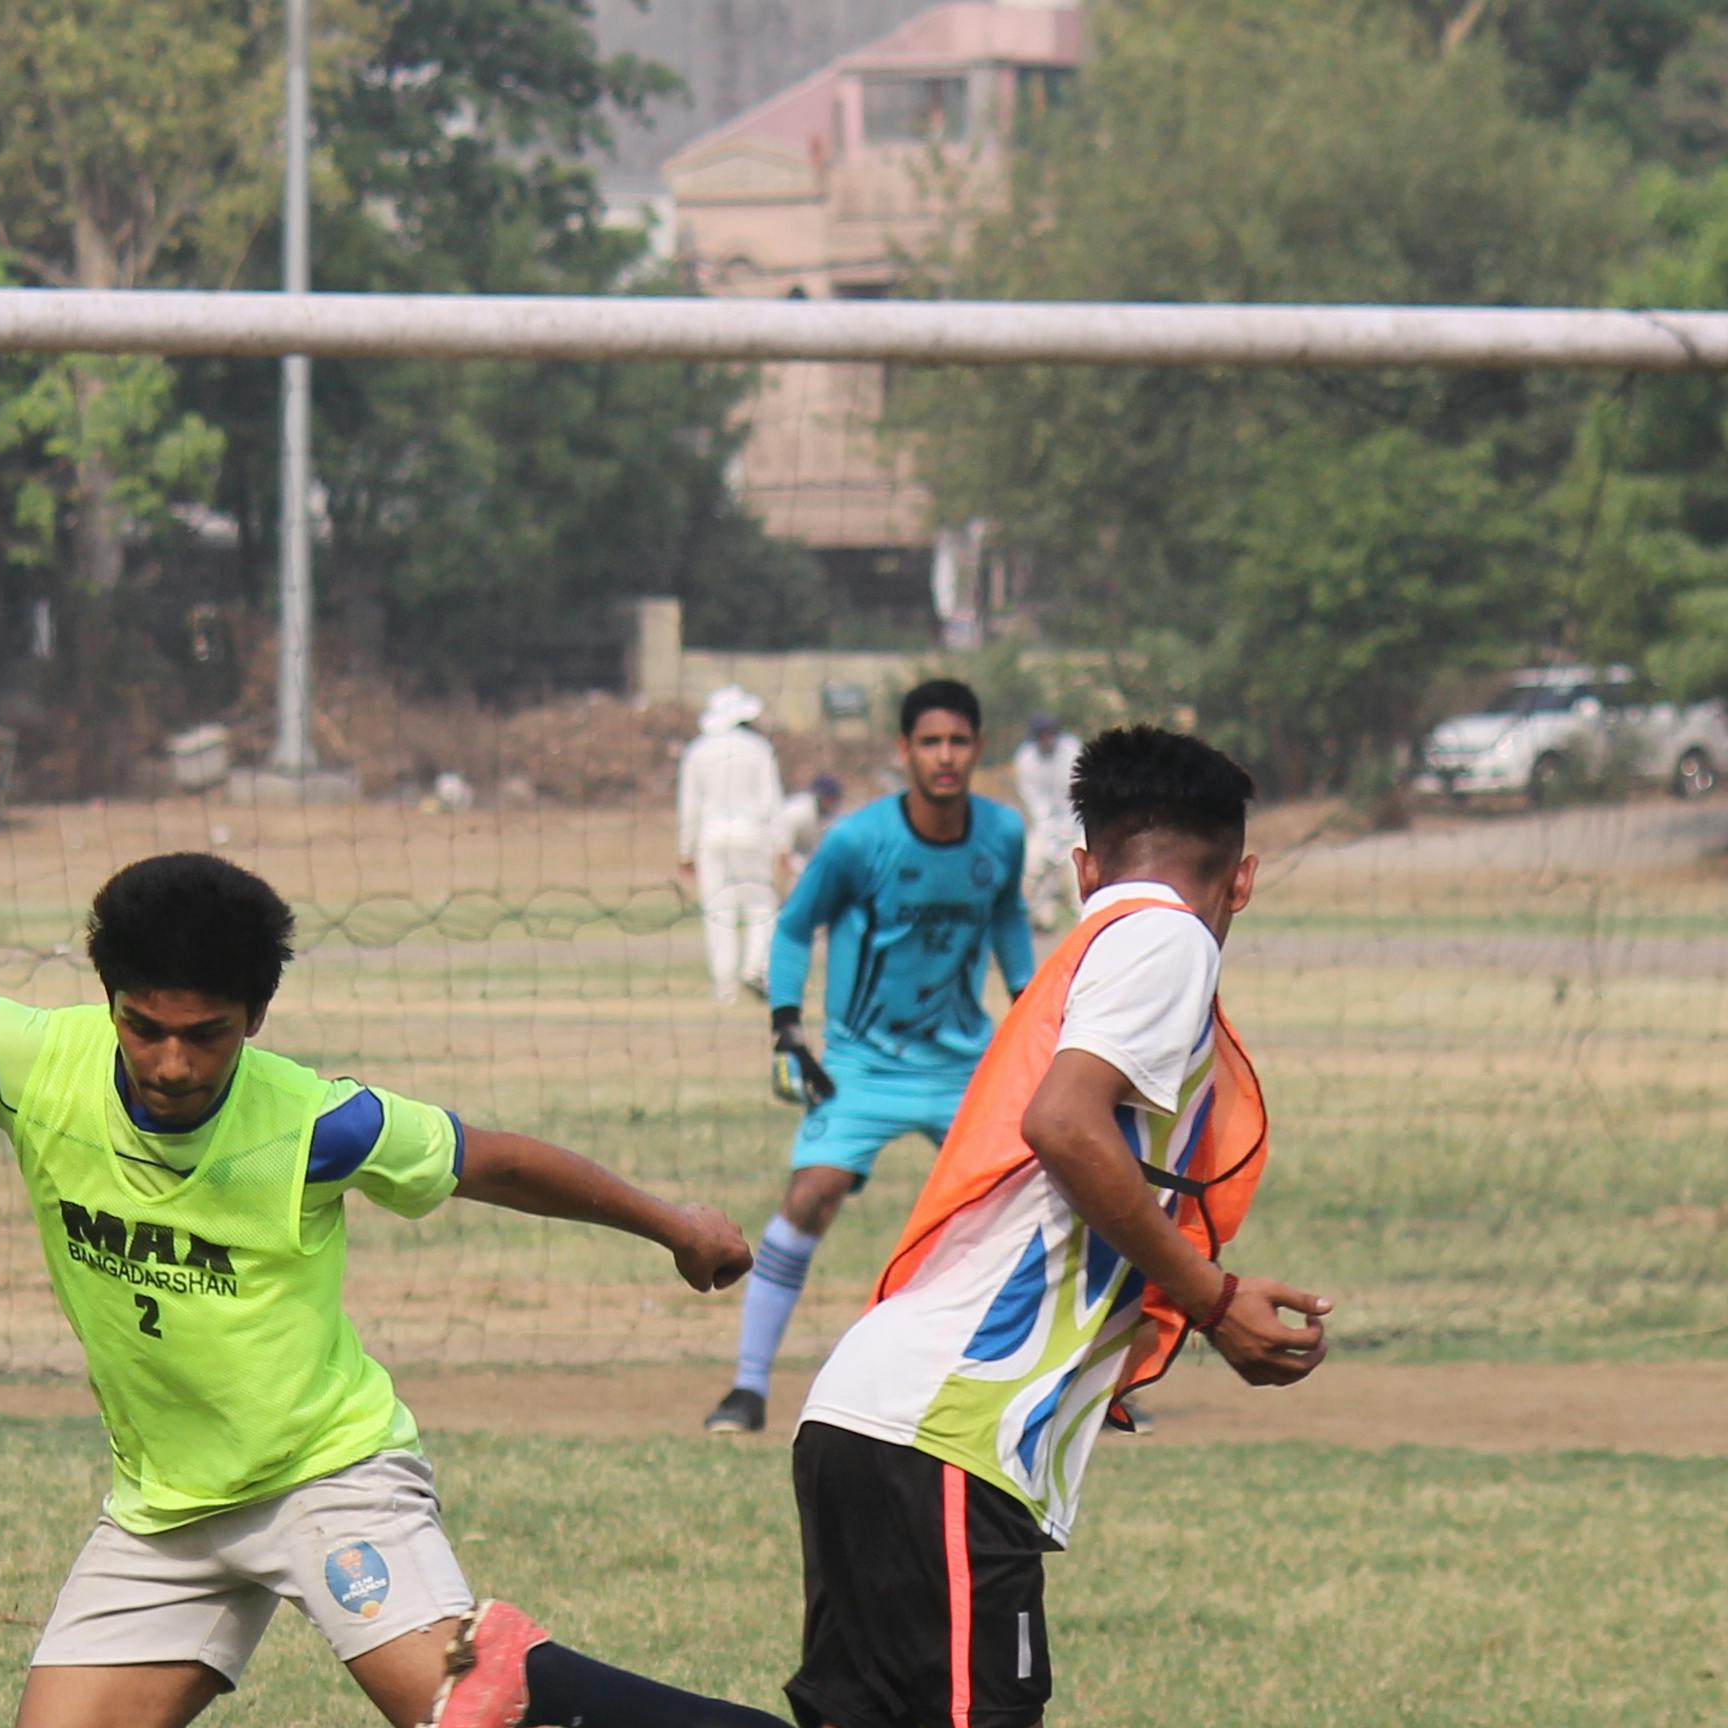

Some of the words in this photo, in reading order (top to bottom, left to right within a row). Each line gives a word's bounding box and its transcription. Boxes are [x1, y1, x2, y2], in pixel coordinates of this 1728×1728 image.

[59, 1198, 238, 1276] MAX
[68, 1241, 238, 1298] BANGADARSHAN
[134, 1293, 163, 1340] 2
